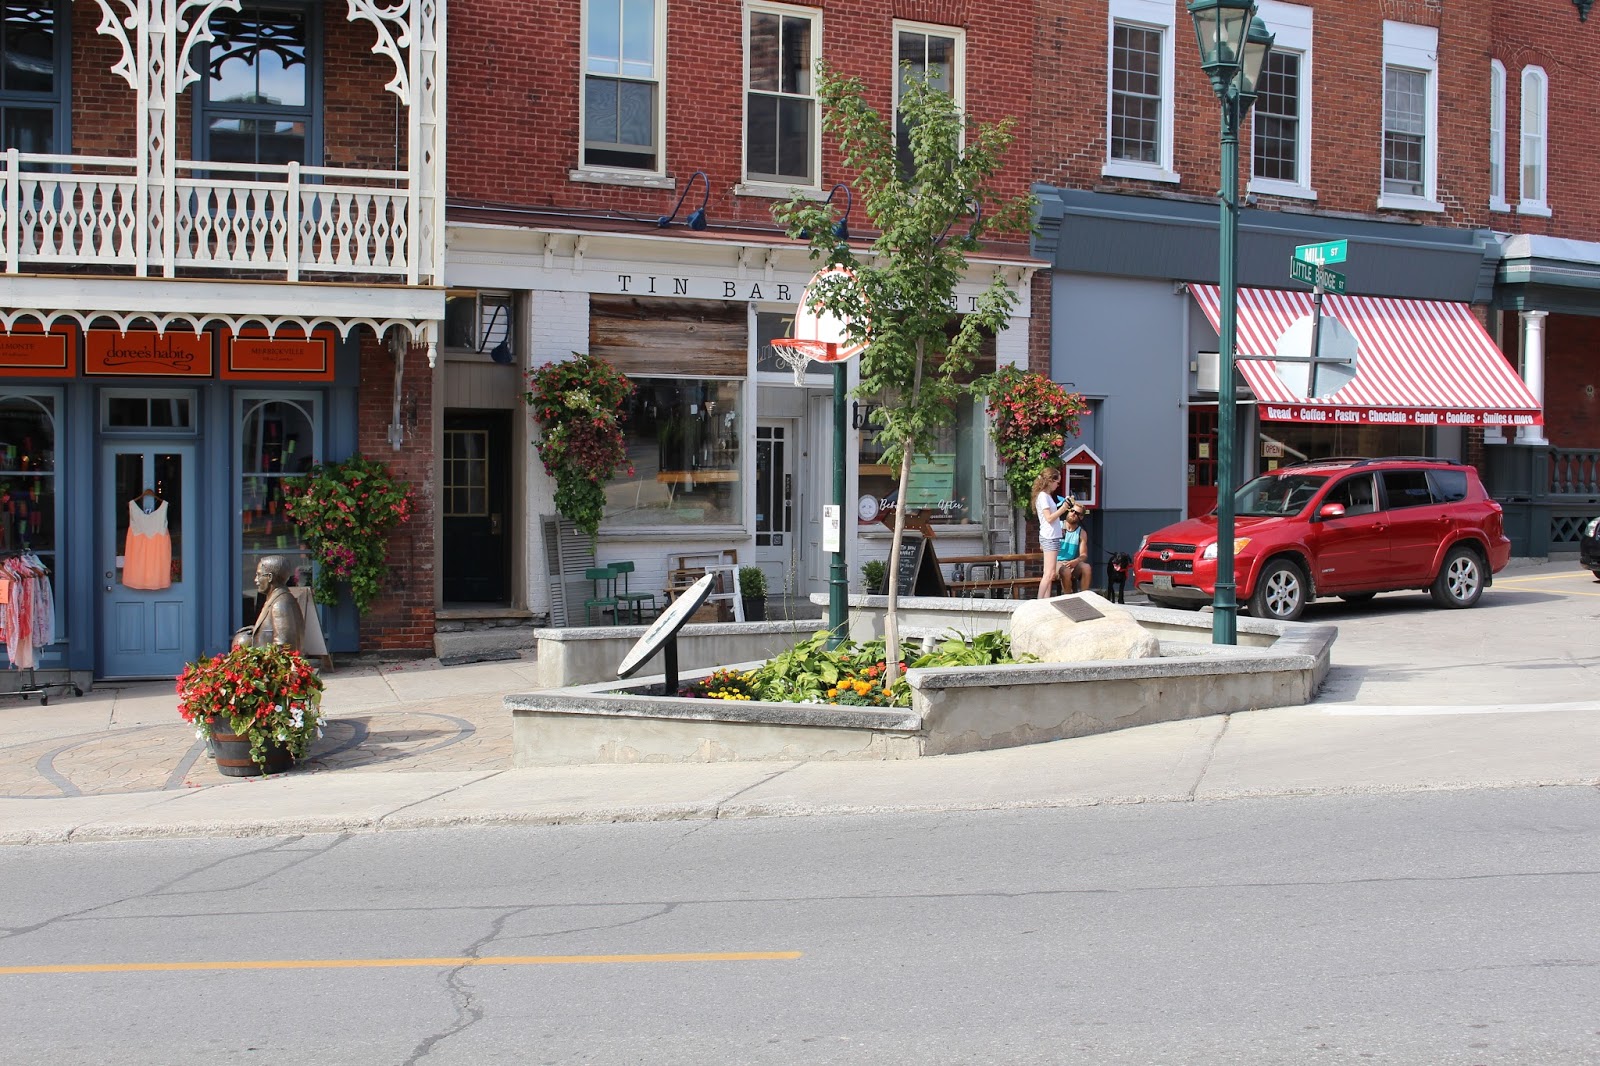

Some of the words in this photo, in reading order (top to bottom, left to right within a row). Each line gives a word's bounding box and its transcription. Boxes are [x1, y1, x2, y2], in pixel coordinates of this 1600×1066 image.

[1305, 247, 1325, 263] MILL
[1330, 248, 1338, 257] ST
[1292, 260, 1312, 281] LITTLE
[1315, 268, 1336, 290] BRIDGE
[1339, 280, 1344, 289] ST
[618, 275, 689, 295] TIN
[723, 280, 807, 301] BAR
[106, 333, 152, 359] doree's
[153, 334, 185, 359] habit
[1267, 406, 1292, 419] Bread
[1300, 408, 1326, 421] Coffee
[1335, 409, 1360, 422] Pastry
[1368, 410, 1407, 423] Chocolate
[1415, 411, 1438, 424] Candy
[1446, 411, 1475, 424] Cookies
[1483, 412, 1507, 424] Smiles
[1508, 415, 1513, 424] &
[1514, 415, 1534, 424] more
[1266, 445, 1280, 454] OPEN
